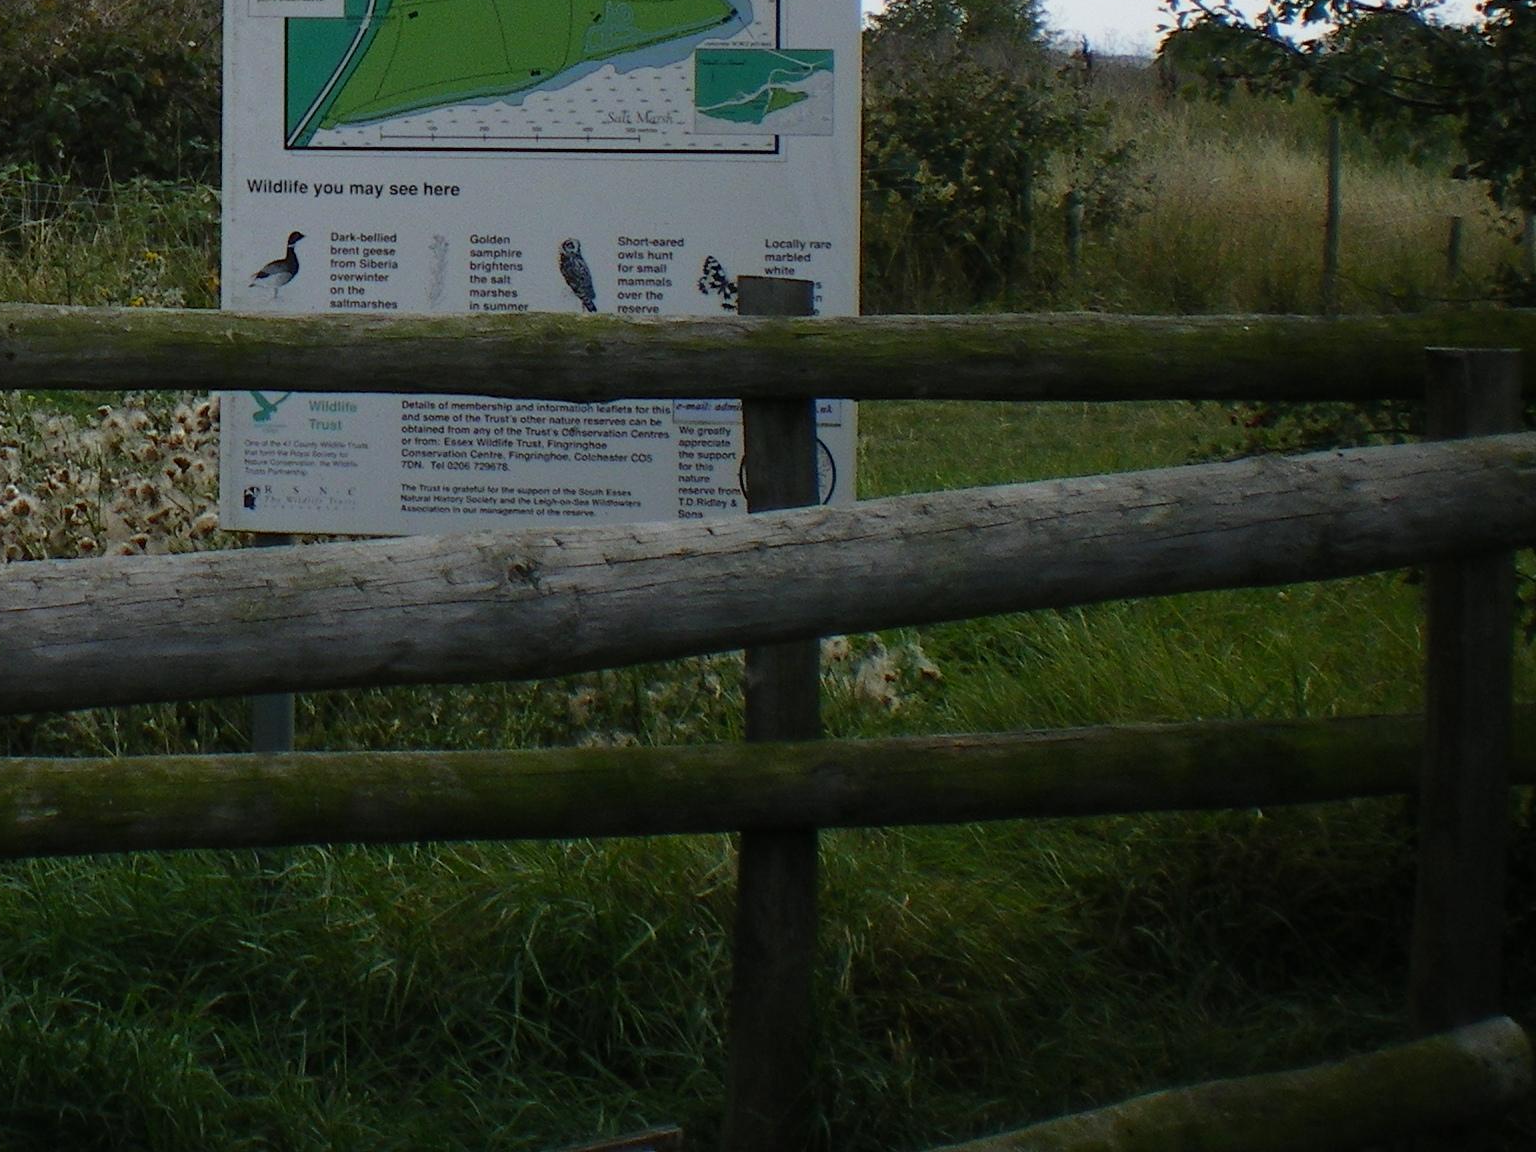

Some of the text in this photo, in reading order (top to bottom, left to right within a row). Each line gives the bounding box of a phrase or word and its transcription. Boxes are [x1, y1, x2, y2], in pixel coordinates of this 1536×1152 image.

[247, 180, 460, 198] Wildlife you may see here
[330, 232, 397, 242] Dark-bellied
[470, 234, 510, 244] Golden
[618, 236, 684, 246] Short-eared
[765, 239, 832, 251] Locally rare
[330, 246, 395, 258] brent geese
[470, 248, 522, 259] samphire
[618, 250, 672, 260] owls hunt
[765, 253, 811, 262] marbled
[330, 259, 398, 269] from Siberia
[469, 261, 523, 272] brightens
[617, 263, 666, 273] for small
[764, 266, 794, 274] white
[330, 273, 388, 281] overwinter
[469, 275, 510, 284] the salt
[617, 277, 672, 287] mammals
[347, 286, 365, 295] the
[469, 288, 518, 297] marshes
[617, 291, 663, 300] over the
[330, 299, 397, 308] saltmarshes
[469, 302, 528, 312] in summer
[617, 305, 659, 314] reserve
[309, 401, 357, 412] Wildlife
[401, 400, 671, 415] Details of membership and information leaflets for this
[309, 418, 342, 430] Trust
[401, 413, 420, 421] and
[423, 414, 449, 422] some
[452, 414, 462, 422] of
[465, 414, 480, 422] the
[520, 415, 545, 424] other
[549, 417, 580, 425] nature
[649, 418, 662, 426] be
[401, 425, 444, 433] obtained
[447, 425, 470, 434] from
[473, 427, 490, 436] any
[493, 427, 504, 435] of
[506, 427, 522, 435] the
[561, 427, 627, 437] Conservation
[630, 429, 670, 439] Centres
[678, 426, 731, 436] We greatly
[444, 437, 473, 446] Essex
[476, 438, 513, 447] Wildlife
[547, 440, 607, 451] Fingringhoe
[678, 439, 730, 448] appreciate
[401, 449, 467, 459] Conservation
[574, 453, 627, 462] Colchester
[678, 450, 736, 461] the support
[430, 460, 444, 469] Tel
[678, 462, 713, 471] for this
[678, 474, 710, 482] nature
[718, 486, 742, 495] from
[730, 499, 737, 507] &
[678, 509, 703, 518] Sons
